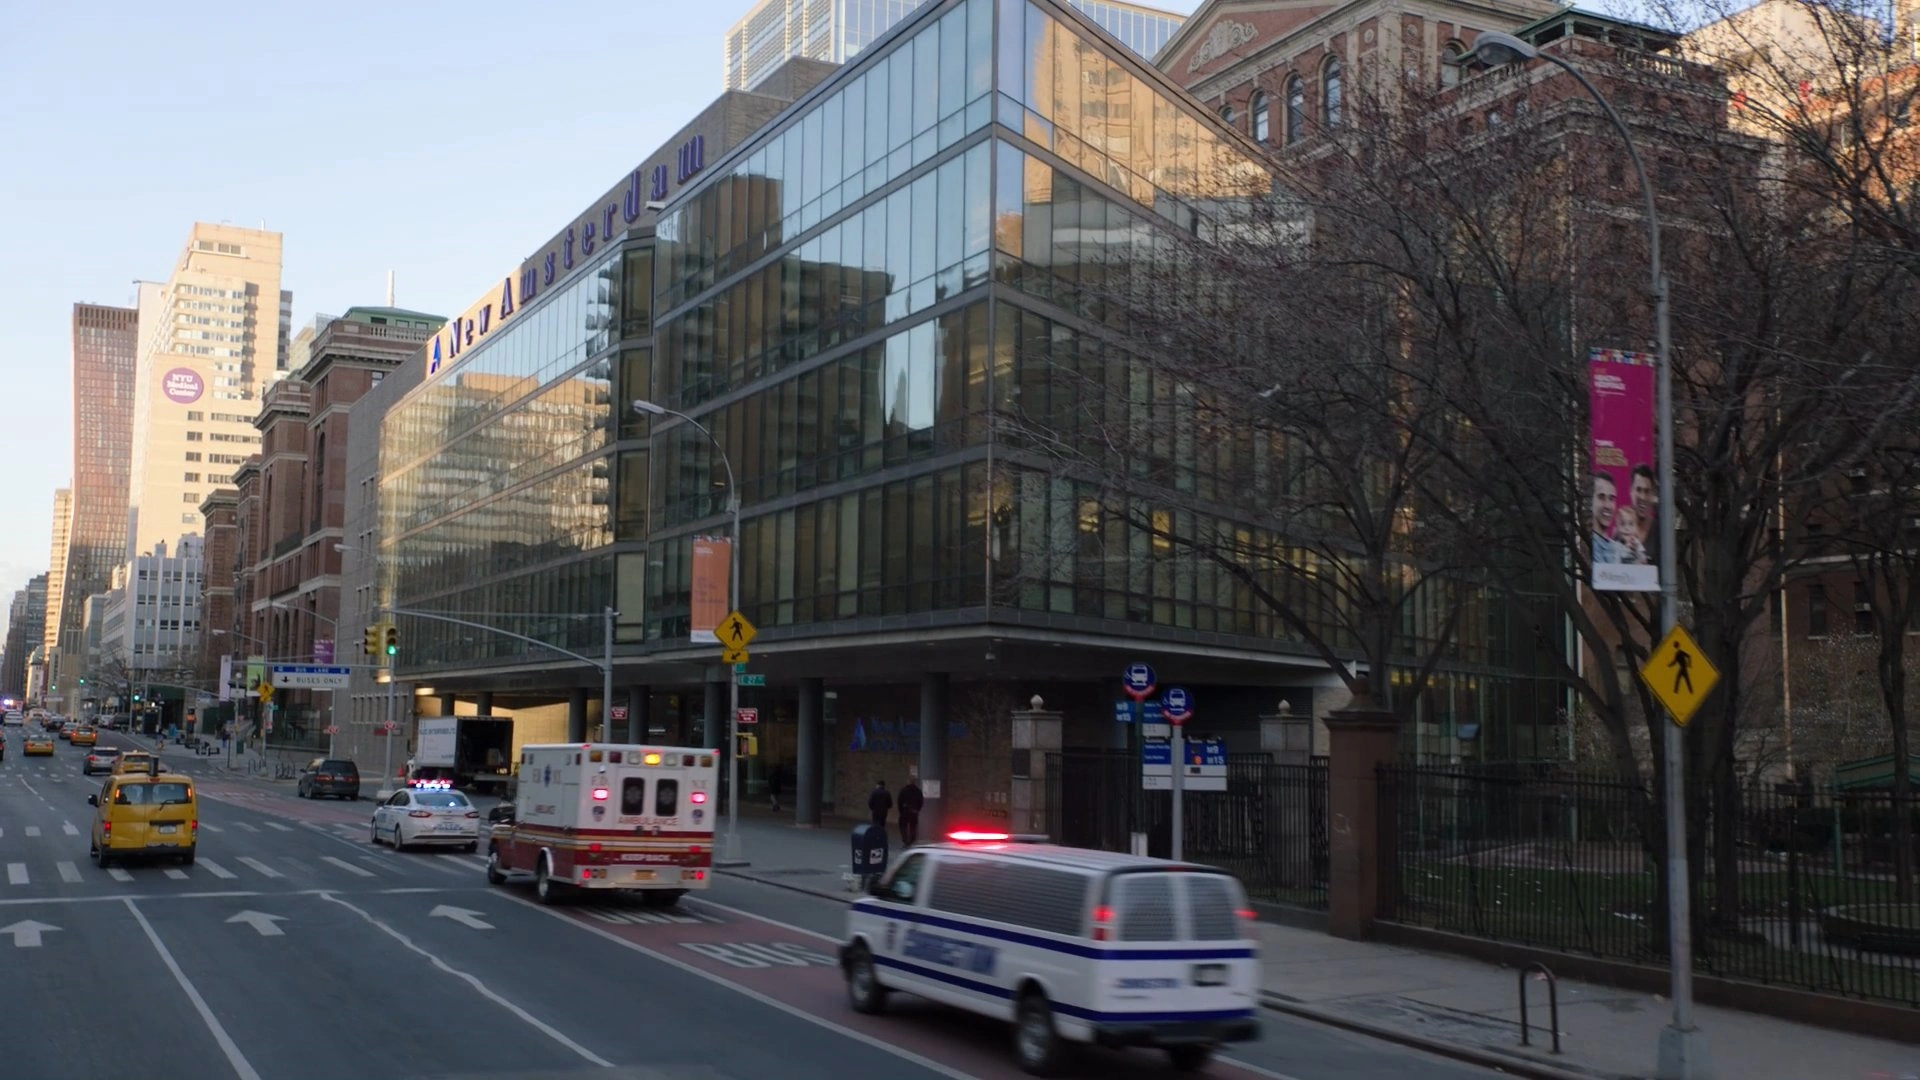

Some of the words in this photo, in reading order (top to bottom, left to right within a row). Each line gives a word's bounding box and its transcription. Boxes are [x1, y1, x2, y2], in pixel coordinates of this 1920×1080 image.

[499, 133, 705, 321] Amsterdam
[171, 373, 194, 383] NYU
[166, 380, 199, 391] Medical
[168, 388, 196, 397] Center
[296, 676, 320, 685] BUSES
[323, 676, 343, 685] ONLY
[1206, 745, 1220, 755] M9
[1206, 755, 1225, 765] M15
[617, 816, 679, 826] AMBULANCE
